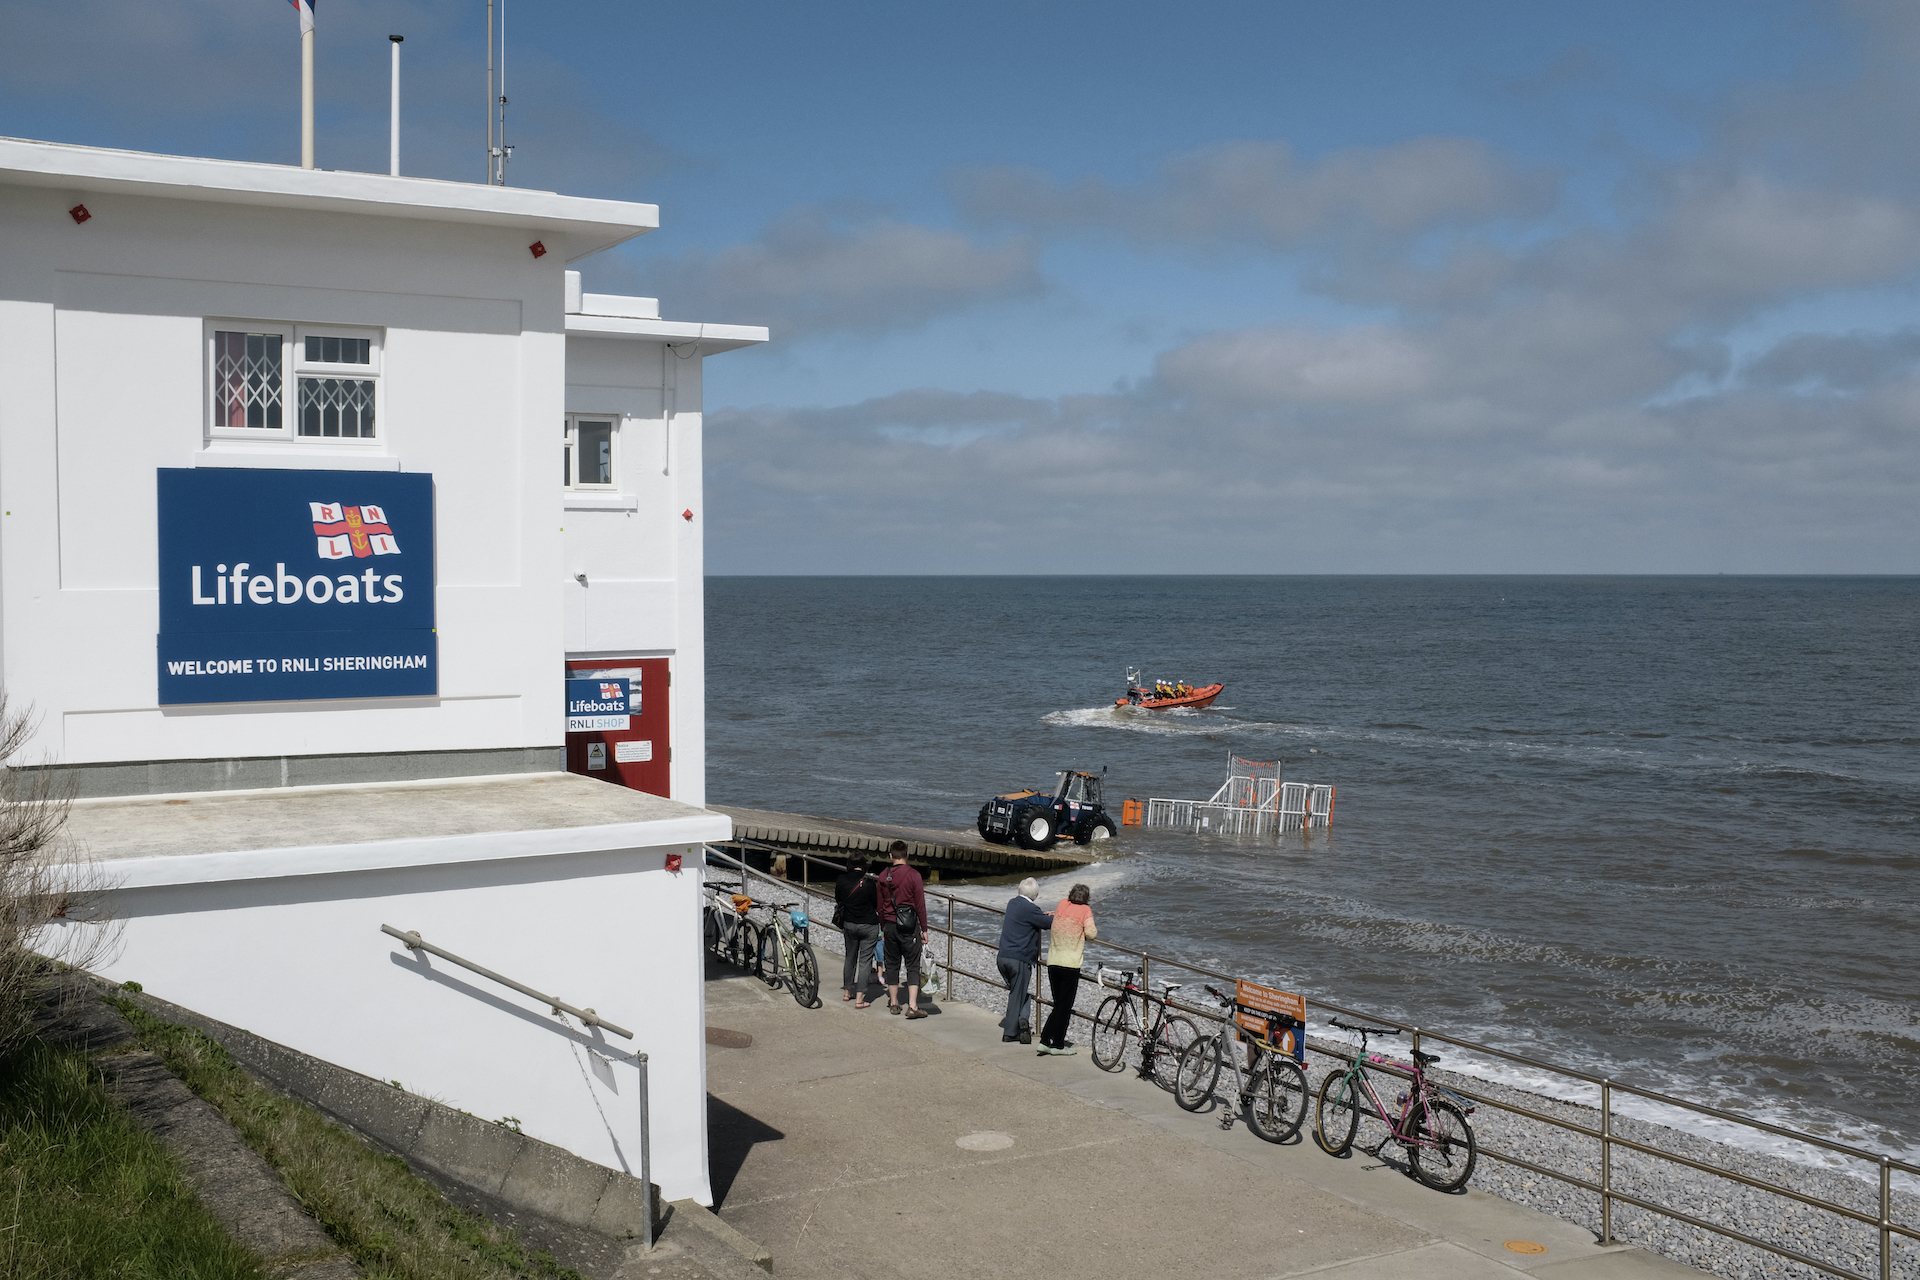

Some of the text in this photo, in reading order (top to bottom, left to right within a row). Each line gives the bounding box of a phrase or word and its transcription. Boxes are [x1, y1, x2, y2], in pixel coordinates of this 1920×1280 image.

[321, 507, 380, 520] R N
[329, 537, 389, 556] L I
[192, 562, 404, 605] Lifeboats
[168, 655, 427, 676] WELCOME TO RNLI SHERINGHAM
[570, 700, 625, 713] Lifeboats
[570, 718, 625, 729] RNLI SHOP
[1243, 985, 1262, 996] Welcome
[1268, 992, 1298, 1007] Sheringham
